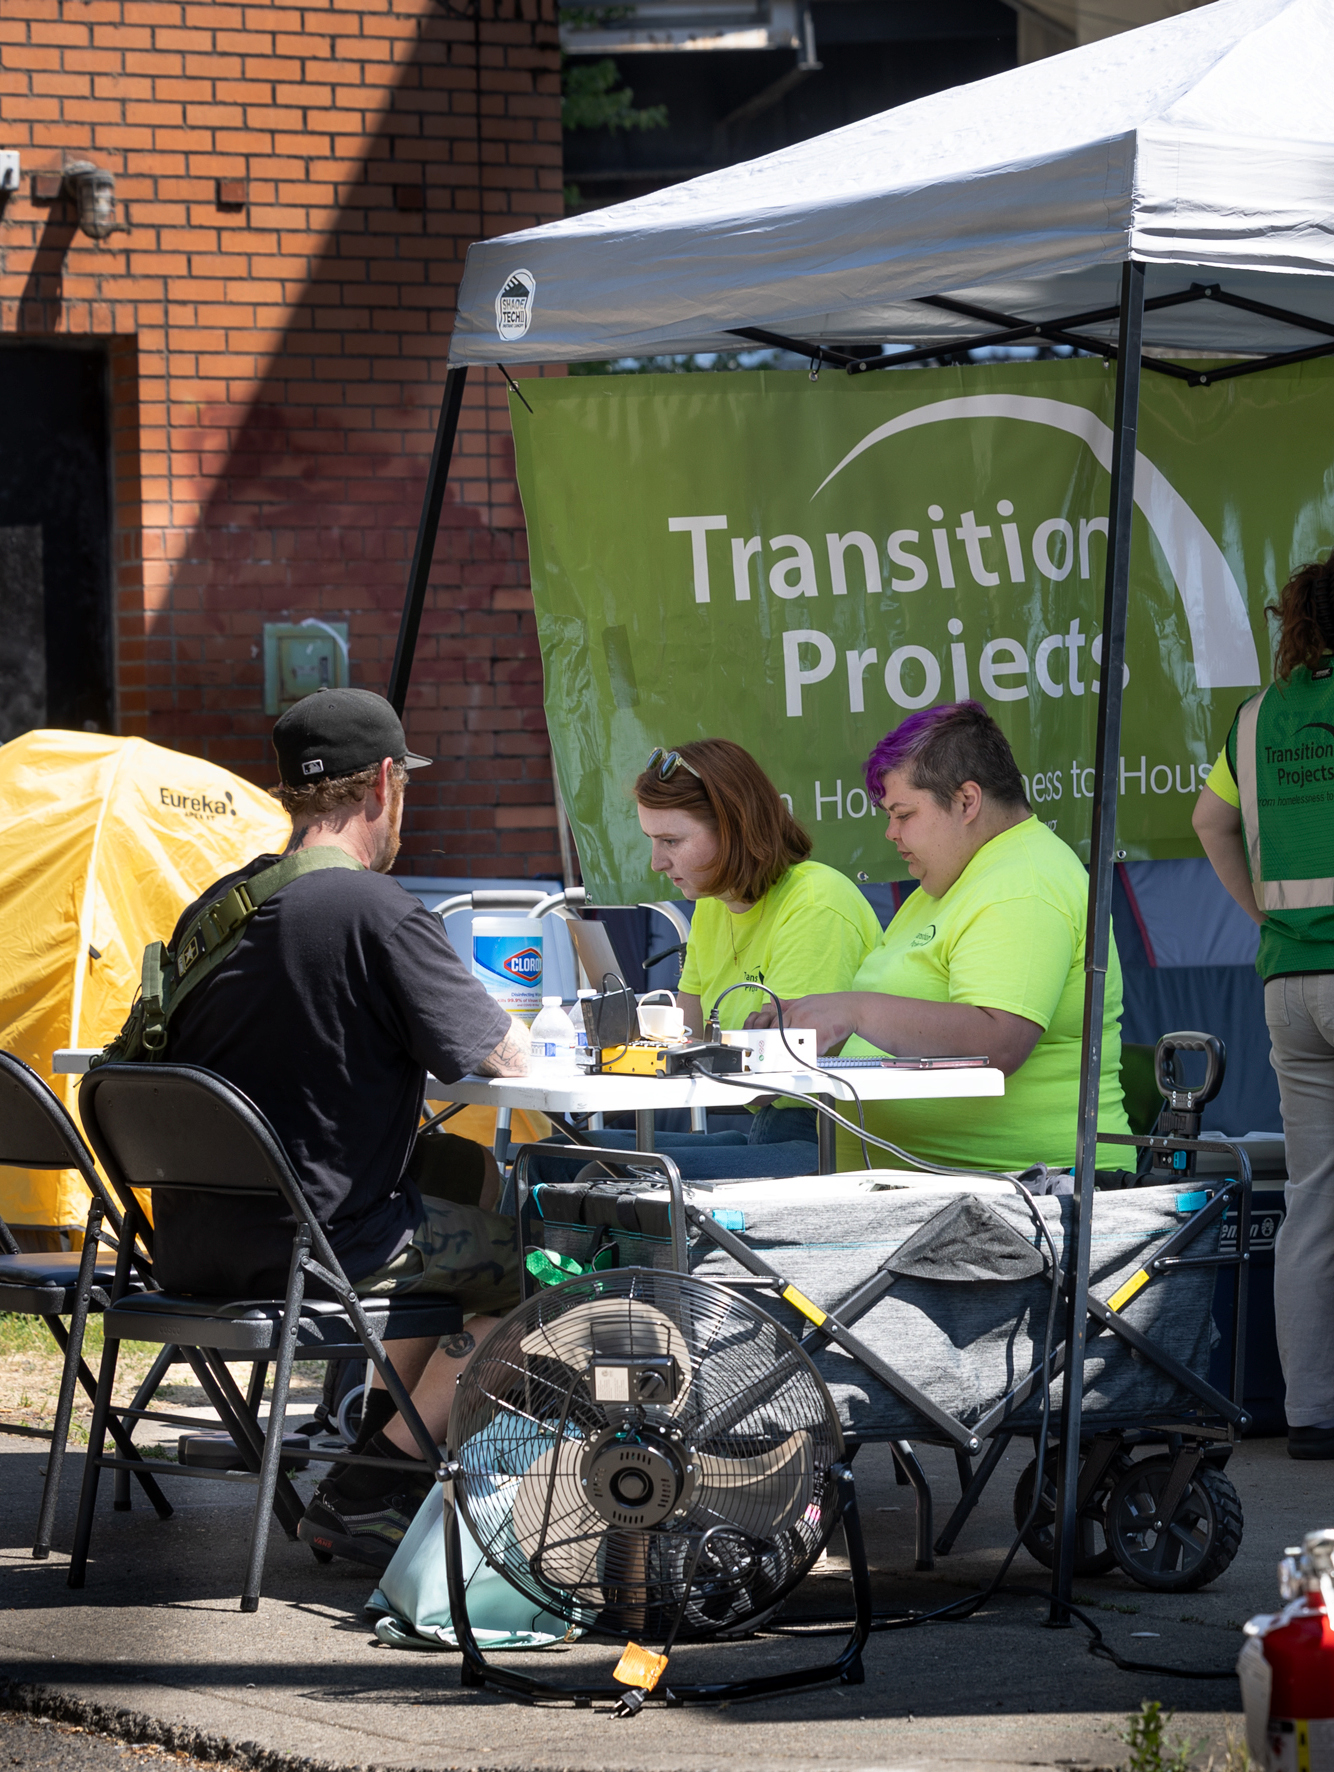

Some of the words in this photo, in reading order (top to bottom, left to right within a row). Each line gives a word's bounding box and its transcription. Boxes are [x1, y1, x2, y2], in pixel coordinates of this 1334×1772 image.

[668, 499, 1110, 603] Transition
[1265, 742, 1333, 764] Transition
[1070, 760, 1096, 798] to
[1119, 752, 1221, 795] Hous
[1277, 765, 1334, 788] Projects
[160, 787, 237, 816] Eureka!
[1277, 793, 1325, 806] homelessness
[1327, 791, 1334, 801] to
